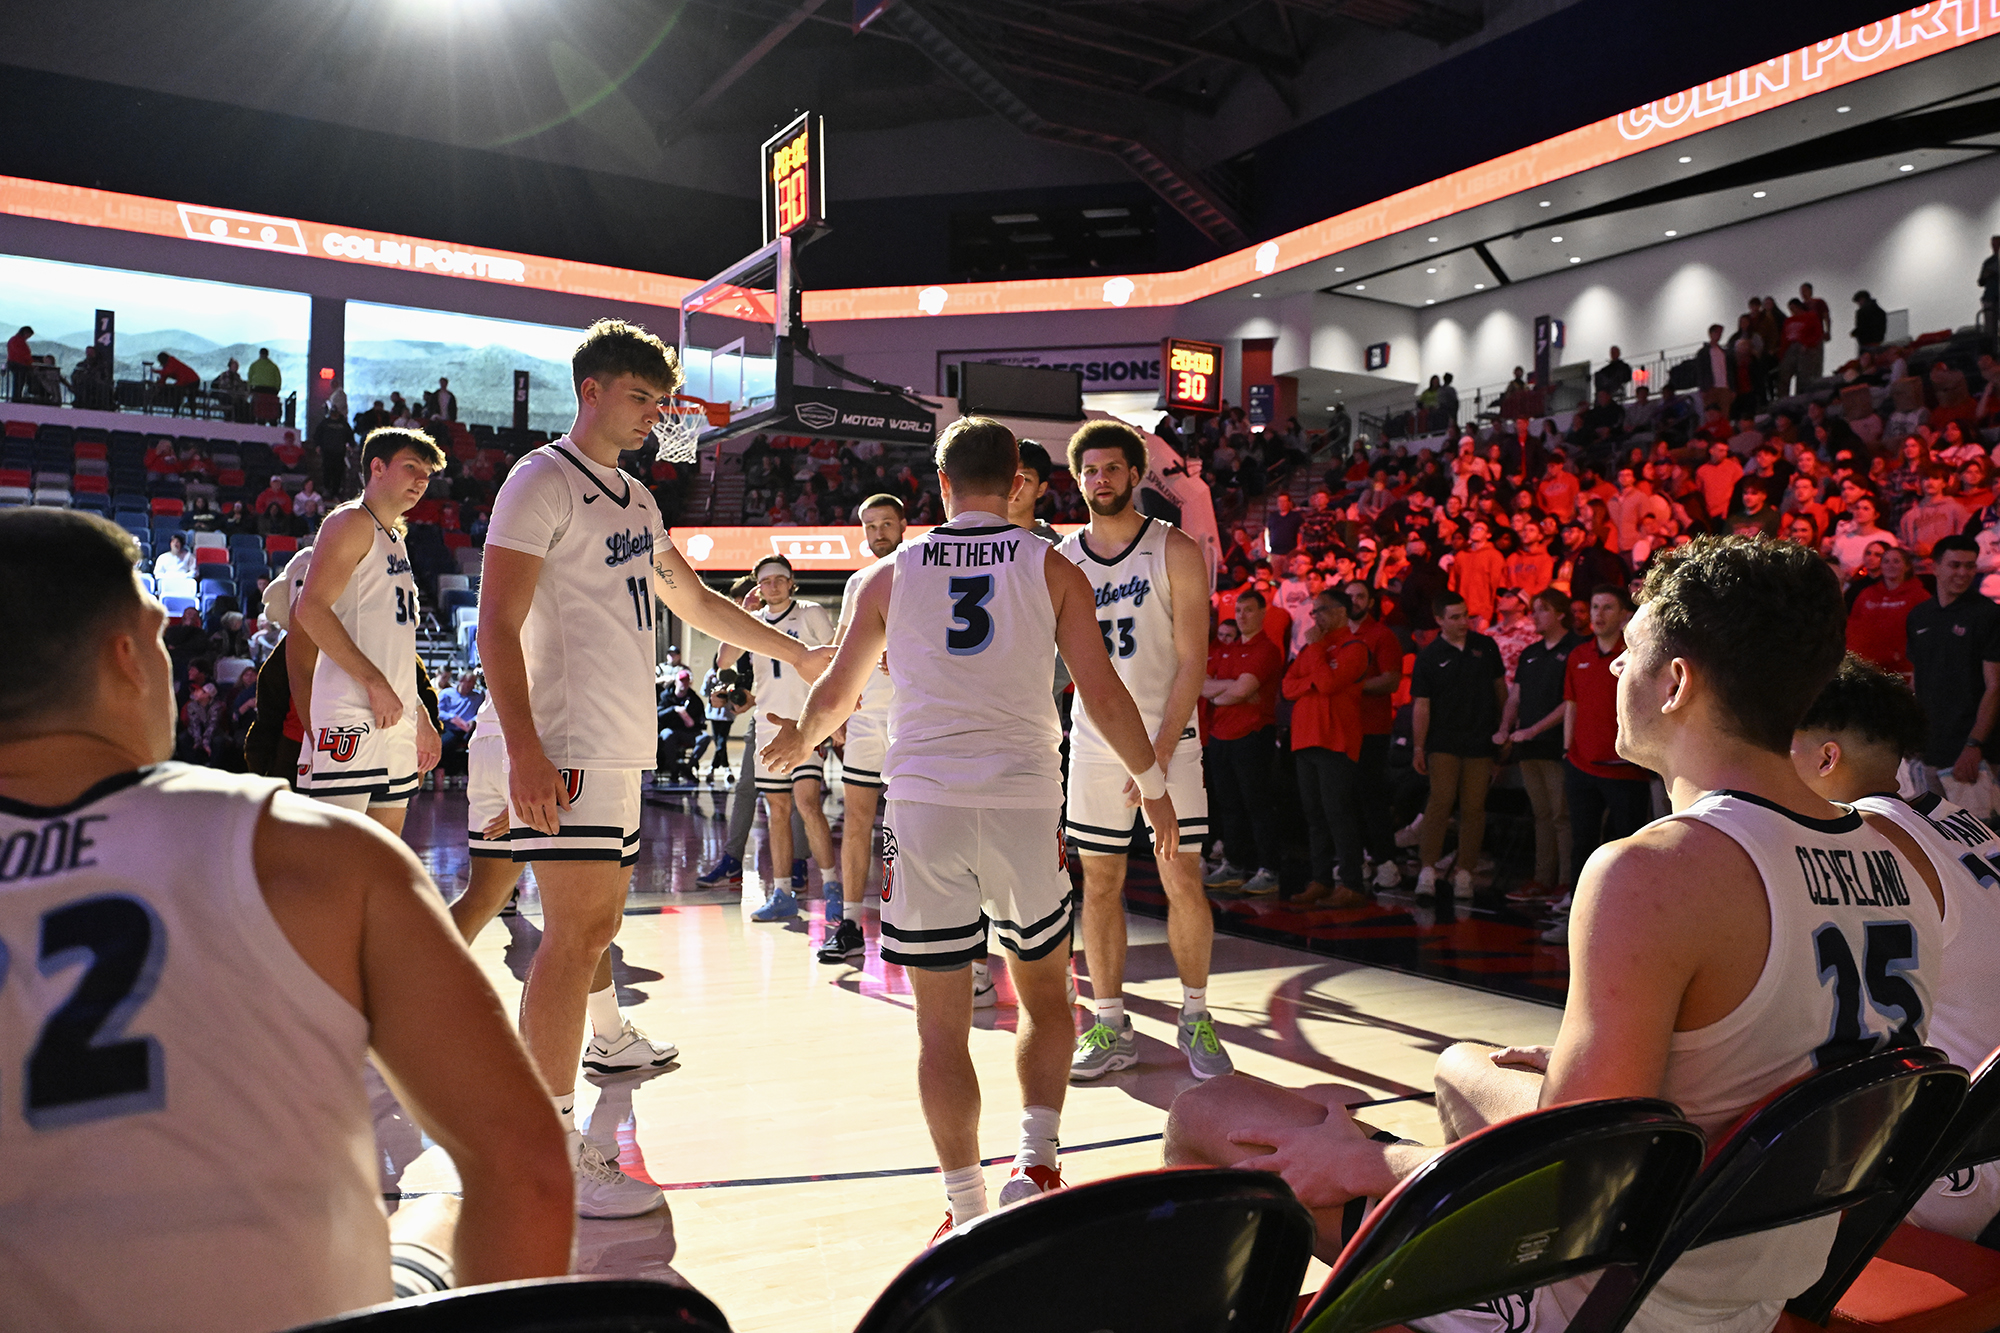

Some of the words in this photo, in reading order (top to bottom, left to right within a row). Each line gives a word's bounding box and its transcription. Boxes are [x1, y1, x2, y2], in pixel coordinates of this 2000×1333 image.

[778, 168, 806, 234] 30
[322, 232, 411, 266] COLIN
[415, 245, 525, 282] PORTER
[1171, 349, 1214, 375] 20:00
[1178, 372, 1207, 401] 30
[841, 414, 885, 428] MOTOR
[889, 418, 932, 433] WORLD
[605, 526, 654, 568] Liberty
[922, 540, 1020, 567] METHENY
[626, 576, 653, 631] 11
[946, 573, 995, 656] 3
[1095, 576, 1151, 609] iberty
[1097, 616, 1138, 660] 33
[0, 814, 109, 882] ODE
[1795, 845, 1910, 907] CLEVELAND
[1809, 919, 1926, 1070] 15
